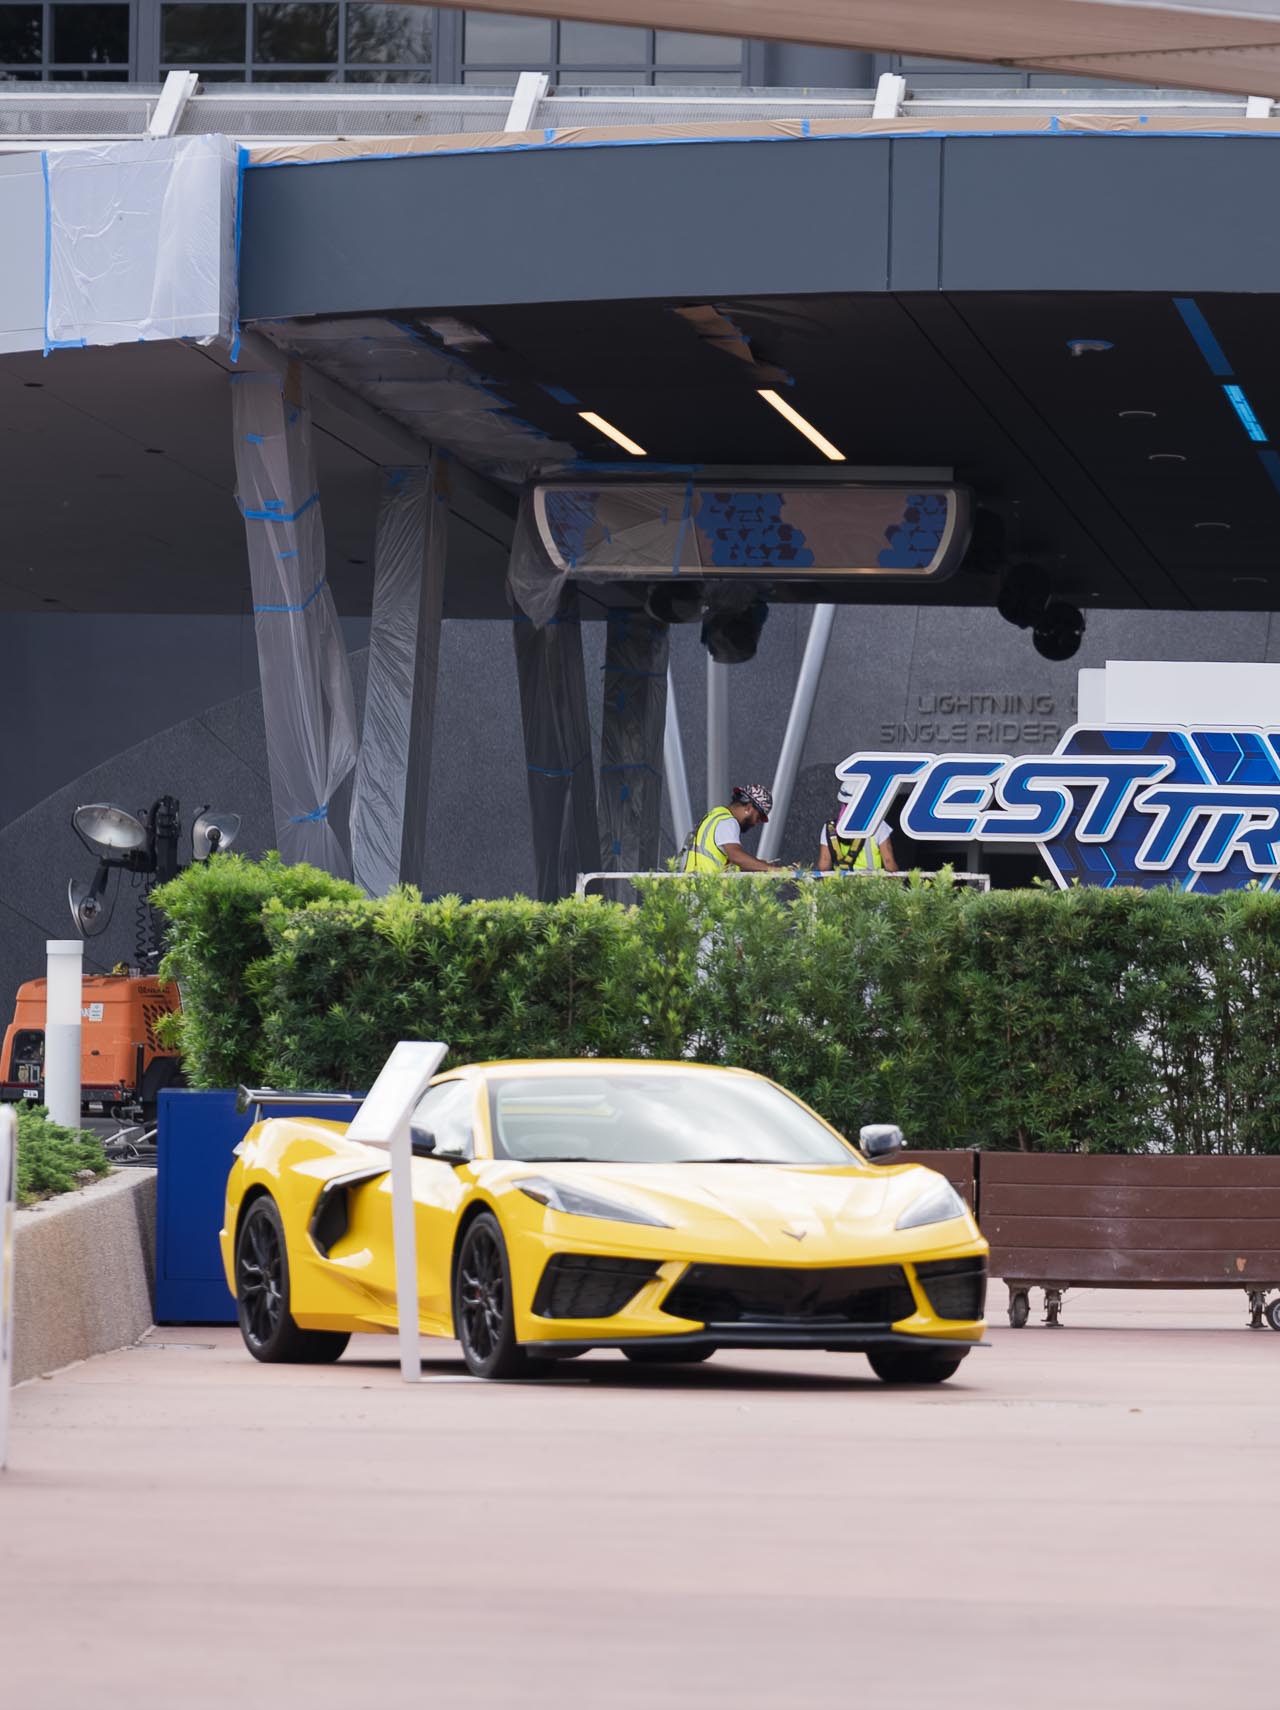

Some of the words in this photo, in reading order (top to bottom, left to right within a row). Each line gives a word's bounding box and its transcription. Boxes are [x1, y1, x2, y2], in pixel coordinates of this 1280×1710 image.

[918, 694, 1056, 715] LIGHTNING
[879, 720, 969, 744] SINGLE
[834, 751, 1176, 842] TEST
